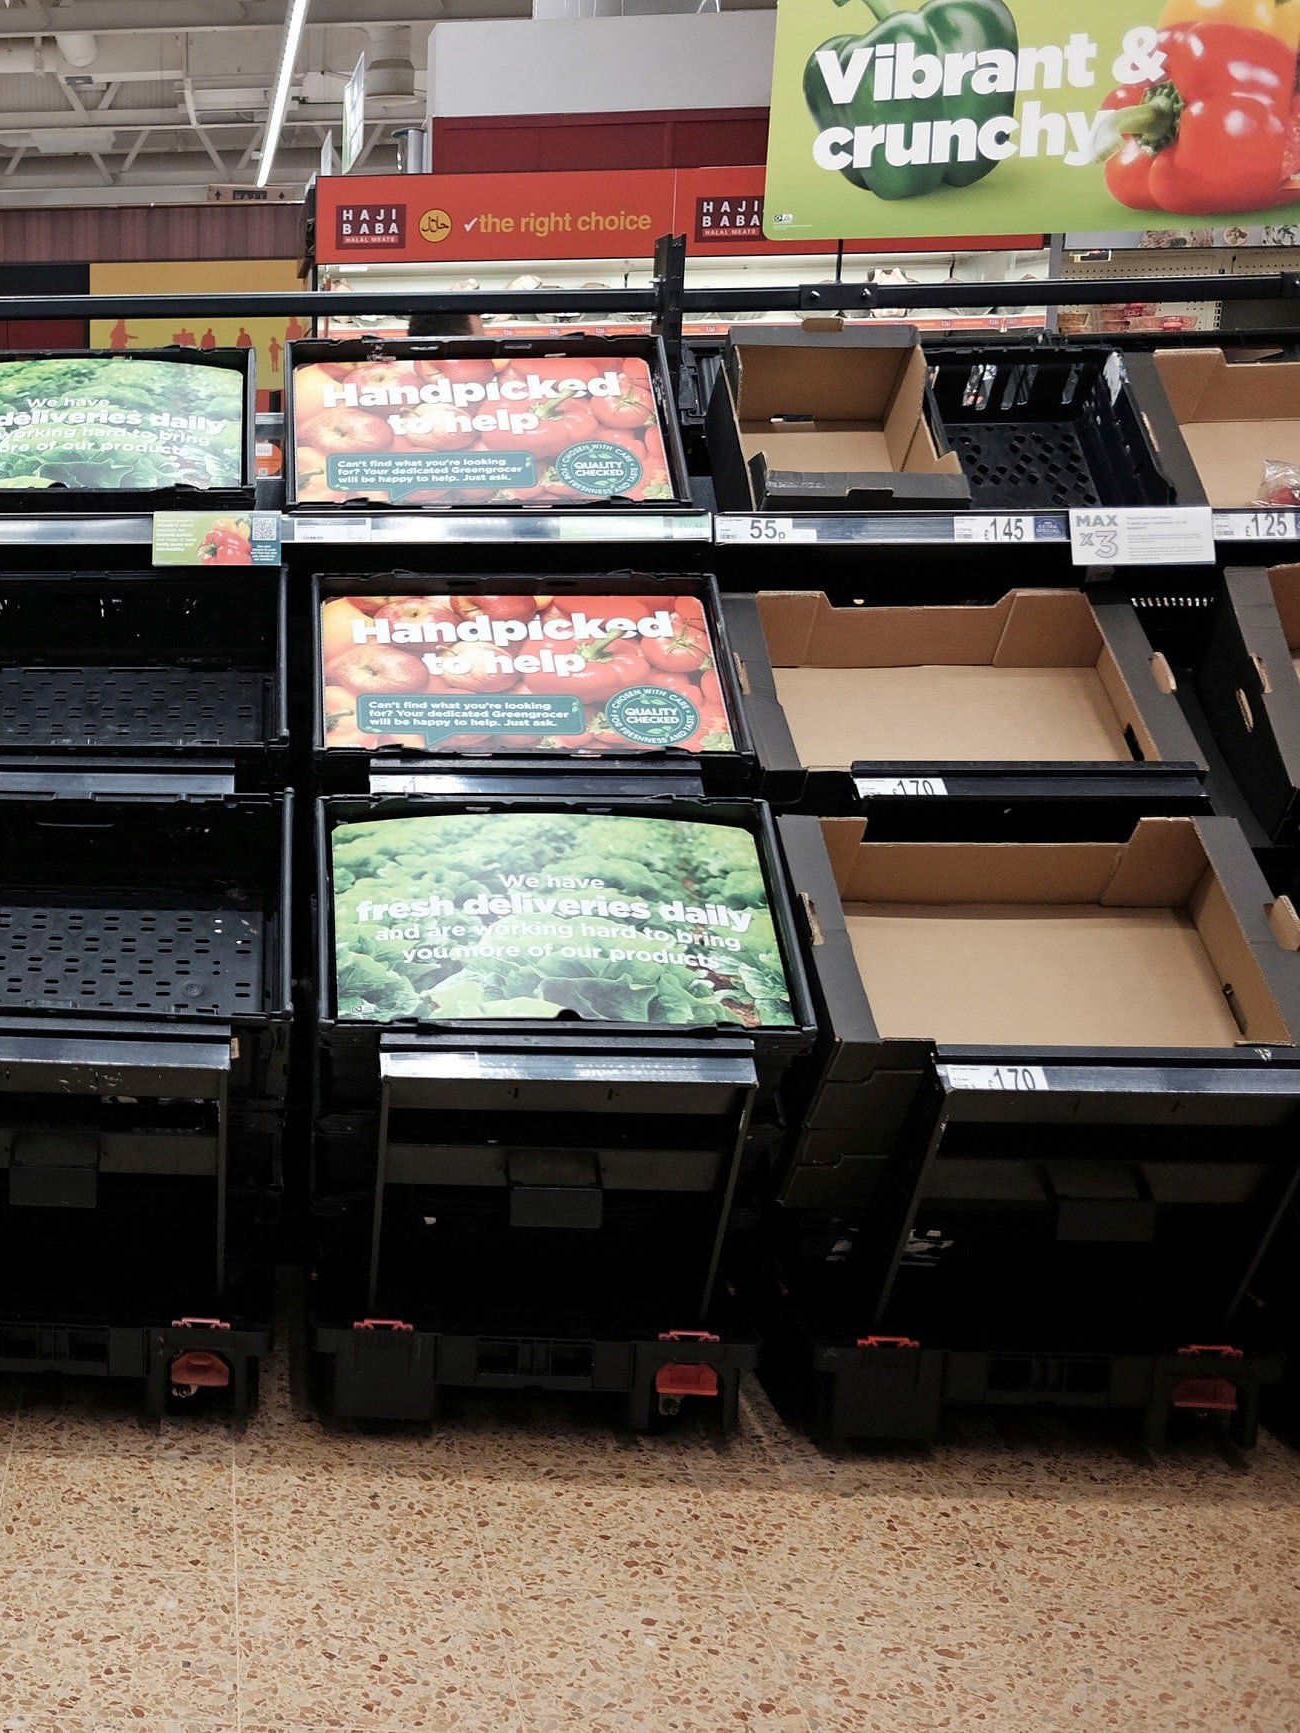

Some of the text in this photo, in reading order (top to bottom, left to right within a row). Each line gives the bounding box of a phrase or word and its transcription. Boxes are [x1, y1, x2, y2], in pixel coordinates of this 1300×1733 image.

[815, 26, 1170, 105] Vibrant &
[812, 100, 1116, 171] crunchy
[343, 209, 396, 221] HAJI
[703, 200, 758, 213] HAJI
[343, 222, 399, 234] BABA
[479, 211, 652, 237] the right choice
[702, 215, 760, 227] BABA
[322, 372, 622, 409] Handpicked
[27, 398, 110, 408] We have
[152, 413, 226, 435] daily
[387, 410, 540, 435] to help
[36, 442, 58, 451] of
[61, 442, 94, 451] our
[83, 426, 126, 438] hard
[132, 431, 151, 442] to
[160, 430, 211, 447] bring
[750, 520, 786, 540] 55p
[985, 518, 1024, 540] £1.45
[1076, 515, 1118, 527] MAX
[1246, 514, 1287, 536] £1.25
[1079, 530, 1119, 559] x3
[351, 611, 674, 646] Handpicked
[421, 649, 587, 677] to help
[368, 701, 400, 709] Can't
[403, 701, 427, 709] find
[464, 702, 500, 710] you're
[504, 702, 552, 710] looking
[369, 709, 393, 717] for?
[427, 710, 488, 718] dedicated
[492, 710, 569, 719] Greengrocer
[624, 708, 677, 716] QUALITY
[369, 718, 557, 727] will be happy to help. Just ask.
[500, 873, 604, 889] We have
[356, 894, 752, 933] fresh deliveries daily
[375, 920, 742, 952] and are working hard to bring
[402, 941, 720, 967] you more of our products
